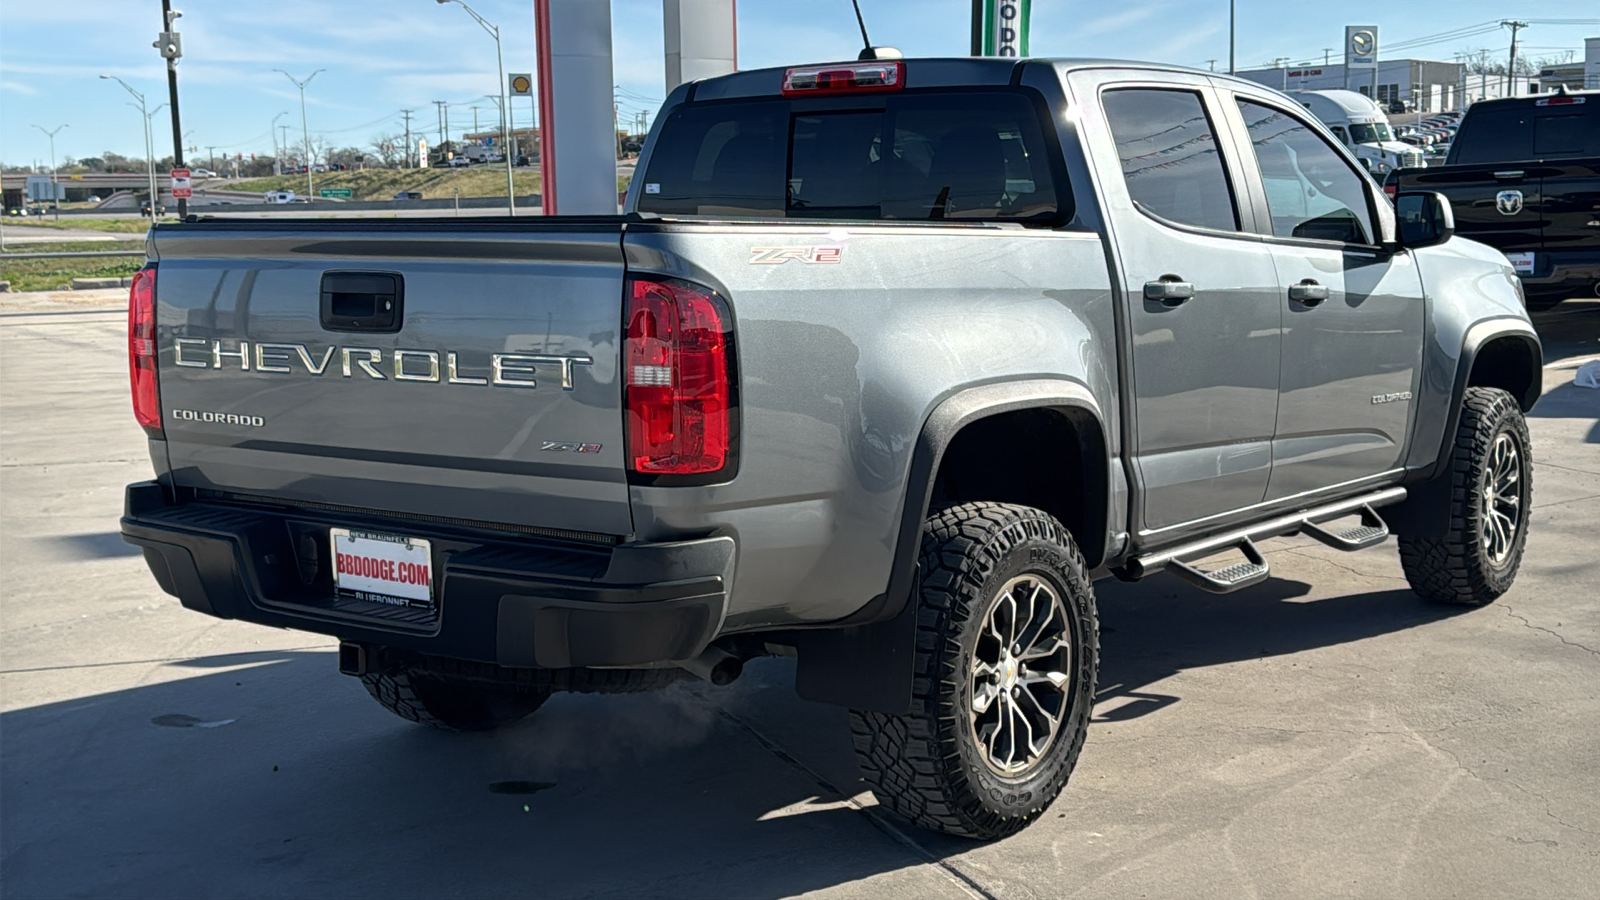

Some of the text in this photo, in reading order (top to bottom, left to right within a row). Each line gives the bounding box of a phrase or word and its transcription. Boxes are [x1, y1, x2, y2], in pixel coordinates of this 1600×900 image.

[749, 246, 843, 264] ZR2
[174, 337, 594, 391] CHEVROLET
[172, 409, 265, 427] COLORADO
[350, 531, 410, 544] NEW BRAUNFELS
[337, 552, 429, 587] BBDODGE.COM
